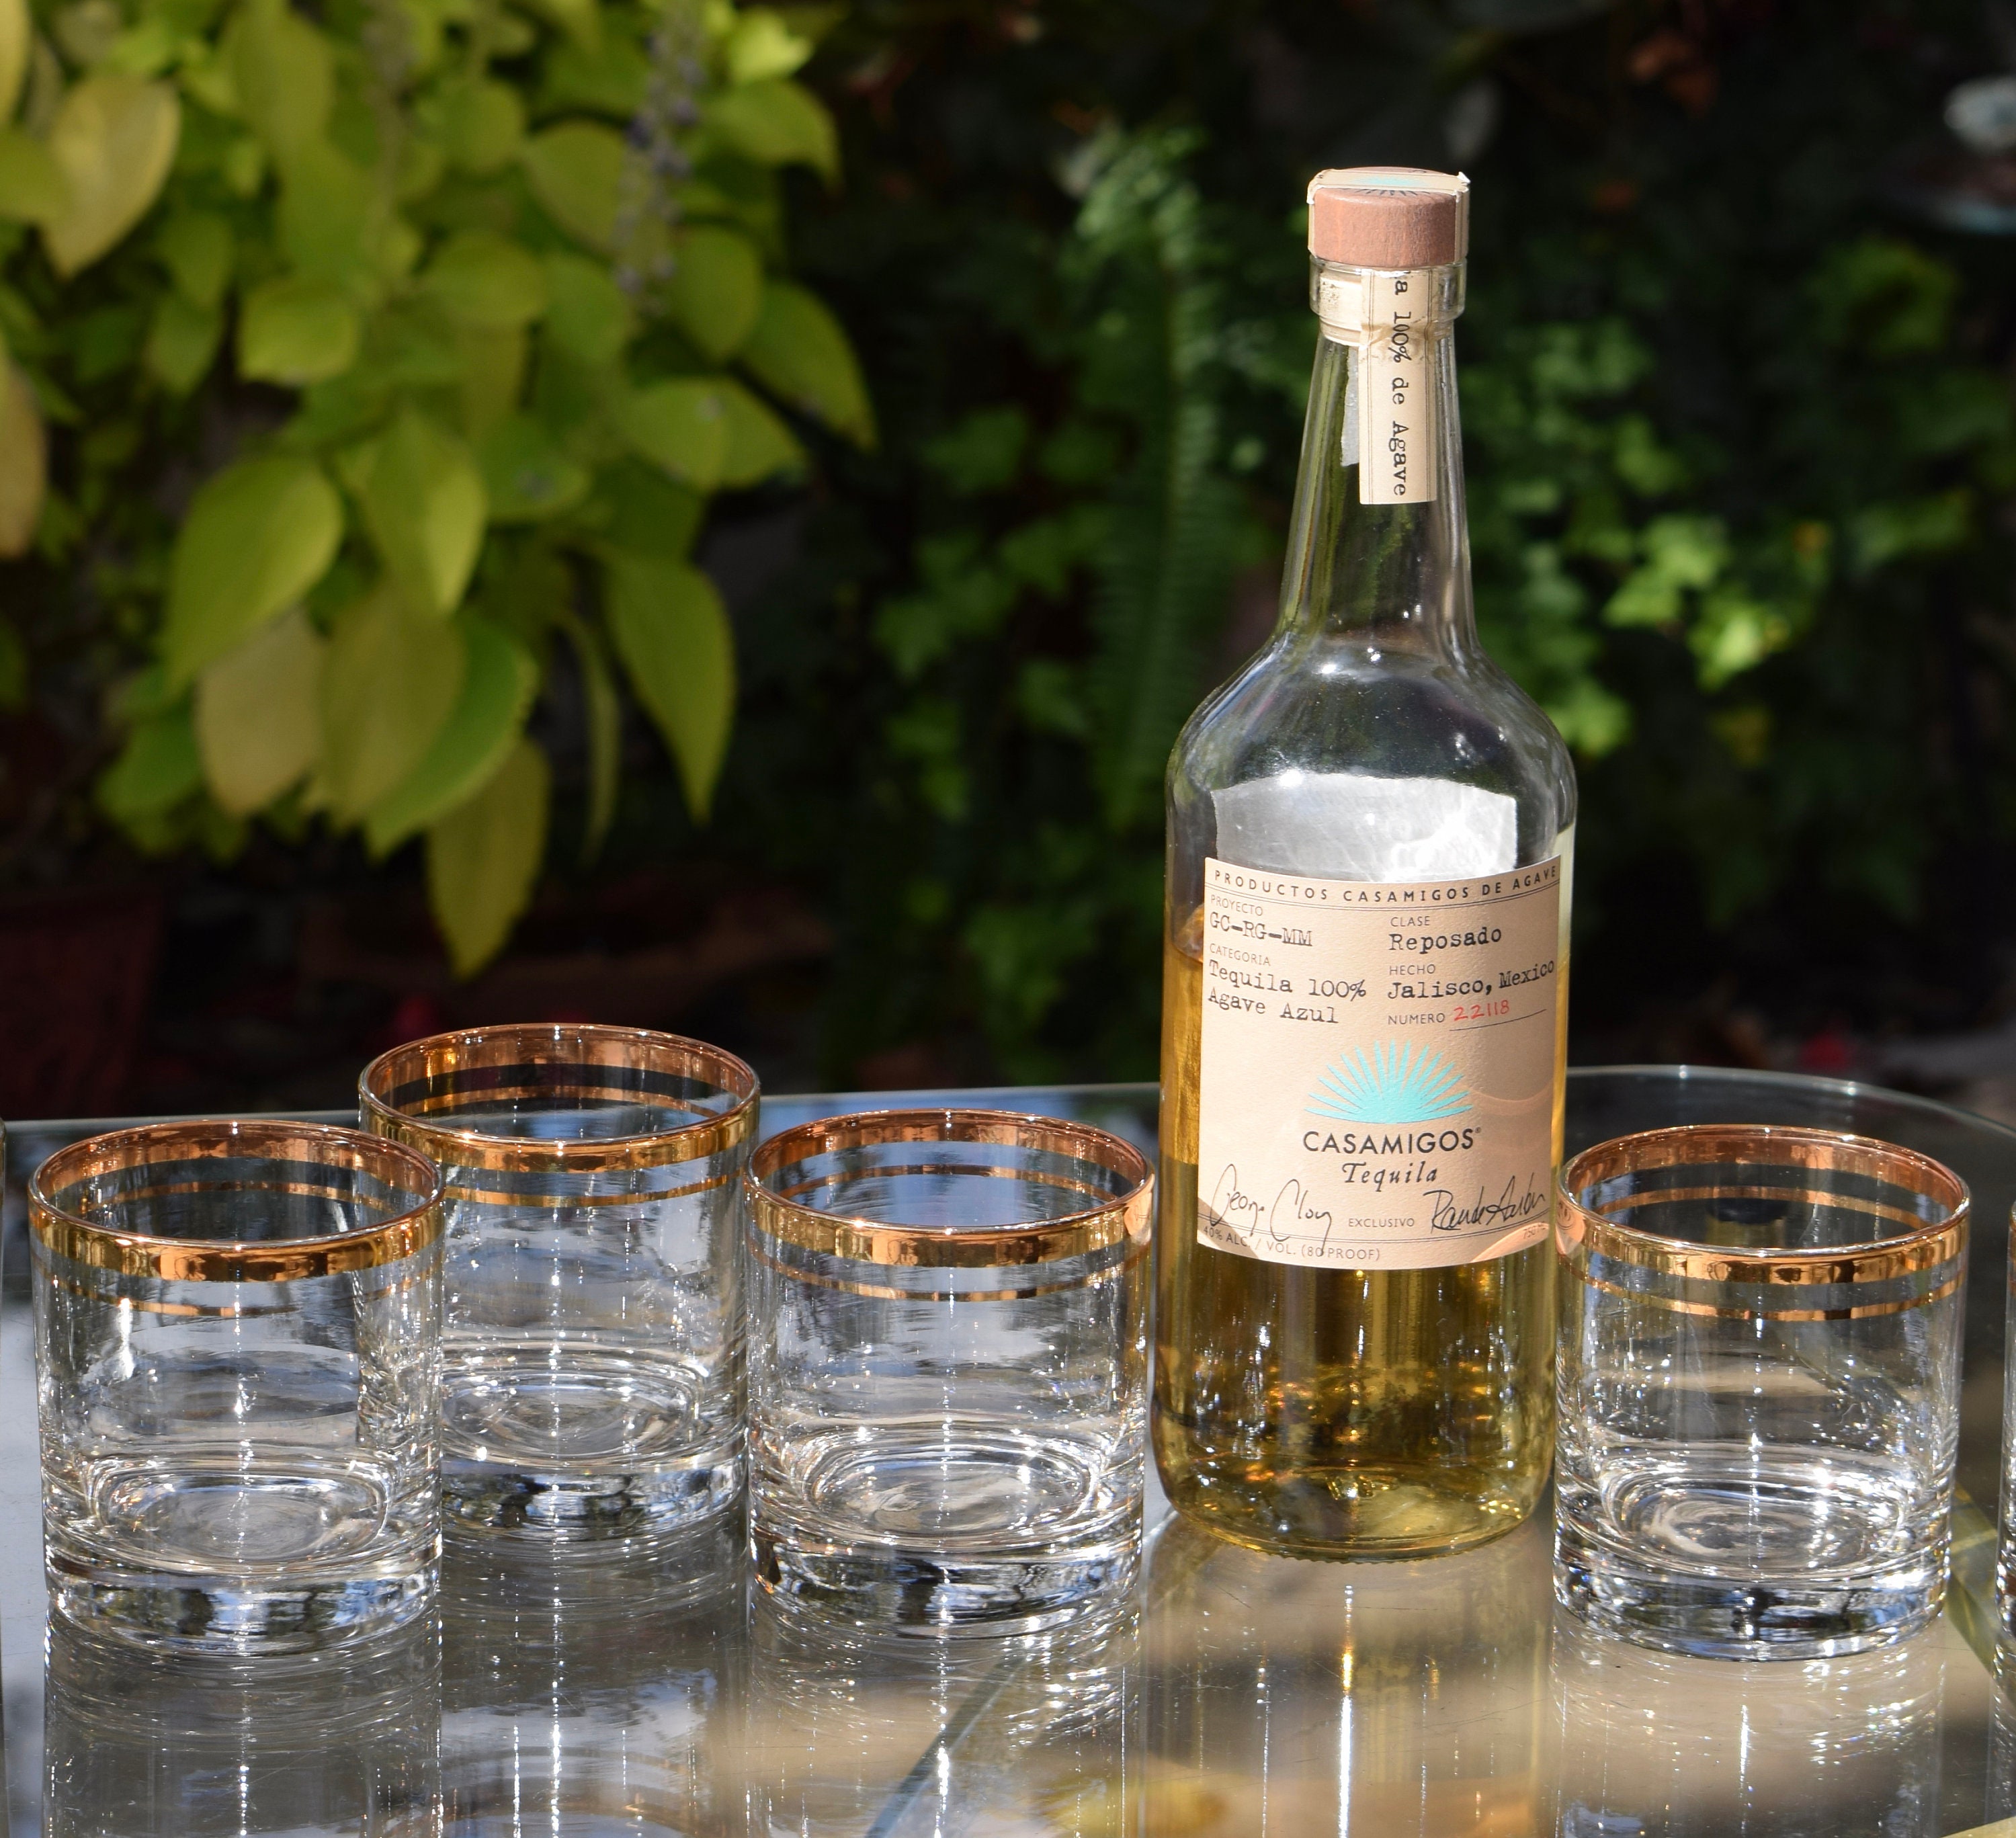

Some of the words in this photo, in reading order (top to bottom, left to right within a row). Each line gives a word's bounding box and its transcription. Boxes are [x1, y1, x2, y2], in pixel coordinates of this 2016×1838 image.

[1388, 311, 1412, 364] 100%
[1392, 377, 1409, 405] de
[1388, 420, 1409, 496] Agave
[1214, 869, 1328, 901] PRODUCTOS
[1343, 887, 1468, 903] CASAMIGOS
[1482, 882, 1501, 896] DE
[1512, 865, 1556, 890] AGAVE
[1210, 894, 1263, 917] PROYECTO
[1390, 915, 1431, 927] CLASE
[1209, 942, 1271, 966] CATEGORIA
[1388, 926, 1503, 954] Reposado
[1208, 959, 1293, 993] Tequila
[1308, 978, 1367, 1002] 100%
[1387, 979, 1492, 999] Jalisco,
[1498, 960, 1554, 989] Mexico
[1389, 963, 1436, 975] HECHO
[1208, 986, 1266, 1011] Agave
[1279, 1002, 1339, 1024] Azul
[1388, 1012, 1445, 1026] NUMERO
[1453, 999, 1510, 1022] 22118
[1302, 1128, 1474, 1155] CASAMIGOS
[1341, 1160, 1438, 1193] Tequila
[1348, 1216, 1415, 1229] EXCLUSIVO
[1203, 1225, 1223, 1241] 40%
[1265, 1240, 1296, 1255] VOL.
[1327, 1247, 1380, 1261] PROOF)
